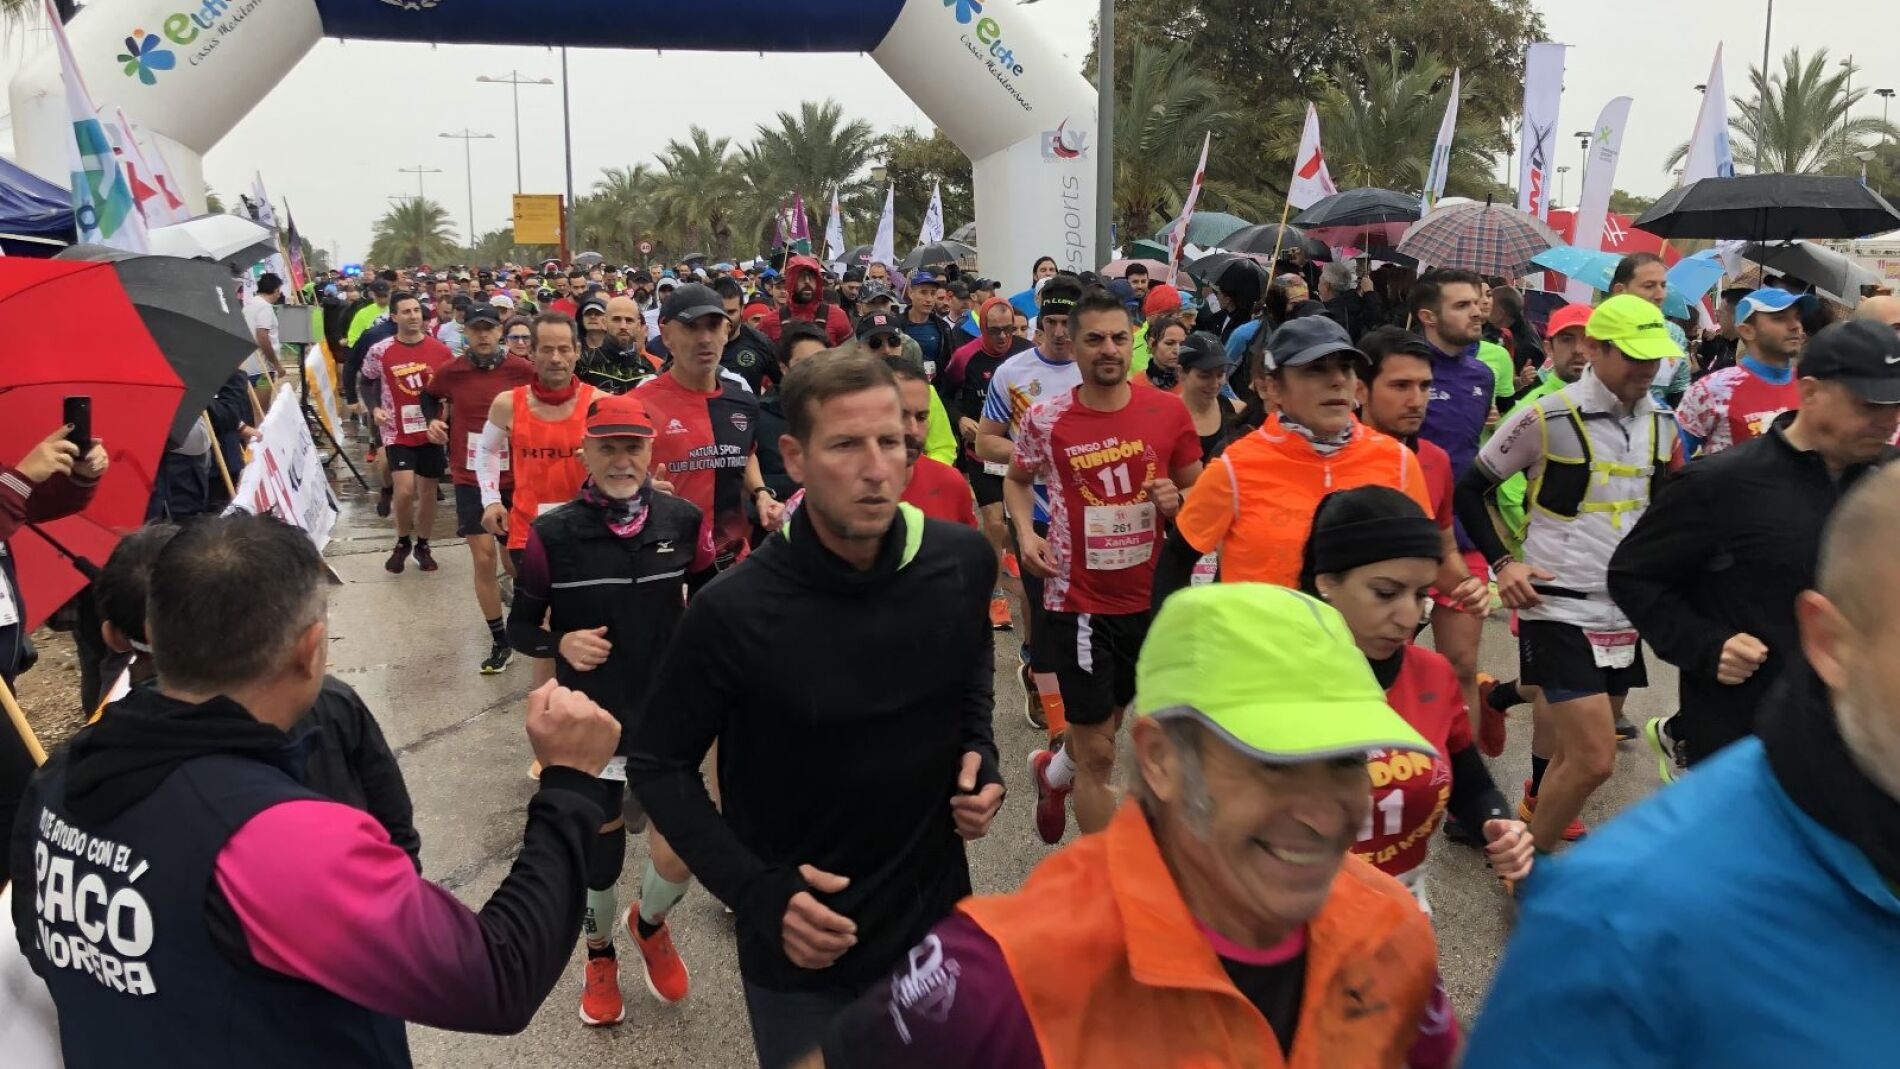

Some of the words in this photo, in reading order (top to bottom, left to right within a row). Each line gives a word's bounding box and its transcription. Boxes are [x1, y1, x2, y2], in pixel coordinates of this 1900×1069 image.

[163, 0, 233, 46] elch
[975, 17, 1024, 77] elche
[405, 372, 423, 389] 11
[689, 445, 719, 458] NATURA
[720, 444, 741, 456] SPORT
[1064, 442, 1101, 457] TENGO
[1102, 436, 1119, 449] UN
[1070, 438, 1144, 470] SUBIDÓN
[668, 461, 688, 473] CLUB
[1096, 462, 1132, 497] 11
[1112, 523, 1131, 533] 261
[50, 819, 88, 857] AYUDO
[87, 837, 115, 868] CON
[112, 844, 132, 873] EL
